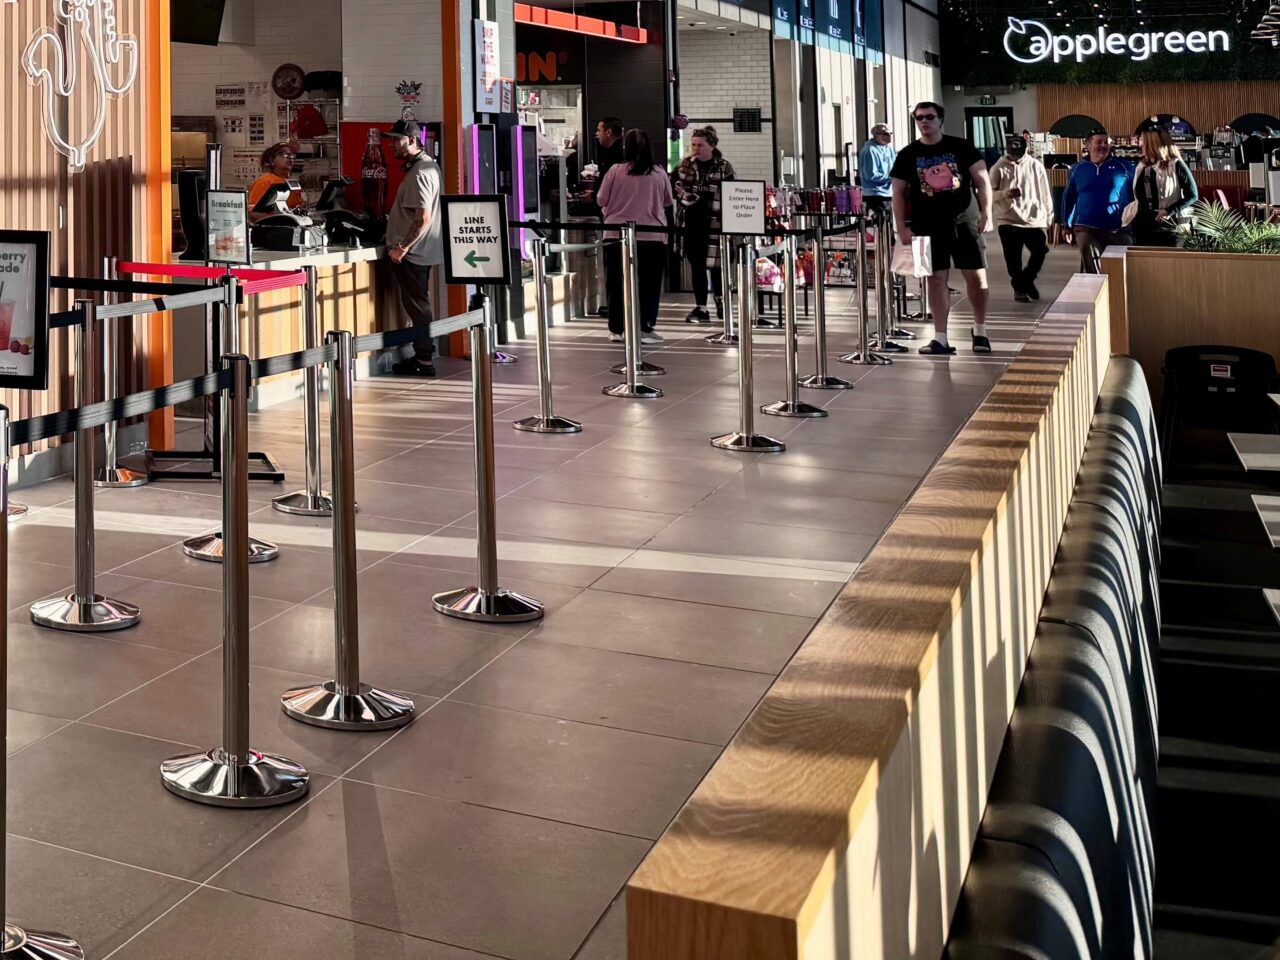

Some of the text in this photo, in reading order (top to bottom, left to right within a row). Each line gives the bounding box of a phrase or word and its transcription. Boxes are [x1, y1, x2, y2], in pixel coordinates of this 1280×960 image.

[1029, 26, 1230, 63] applegreen
[211, 200, 243, 208] Breakfast
[464, 216, 485, 224] LINE
[458, 226, 491, 234] STARTS
[453, 236, 474, 244] THIS
